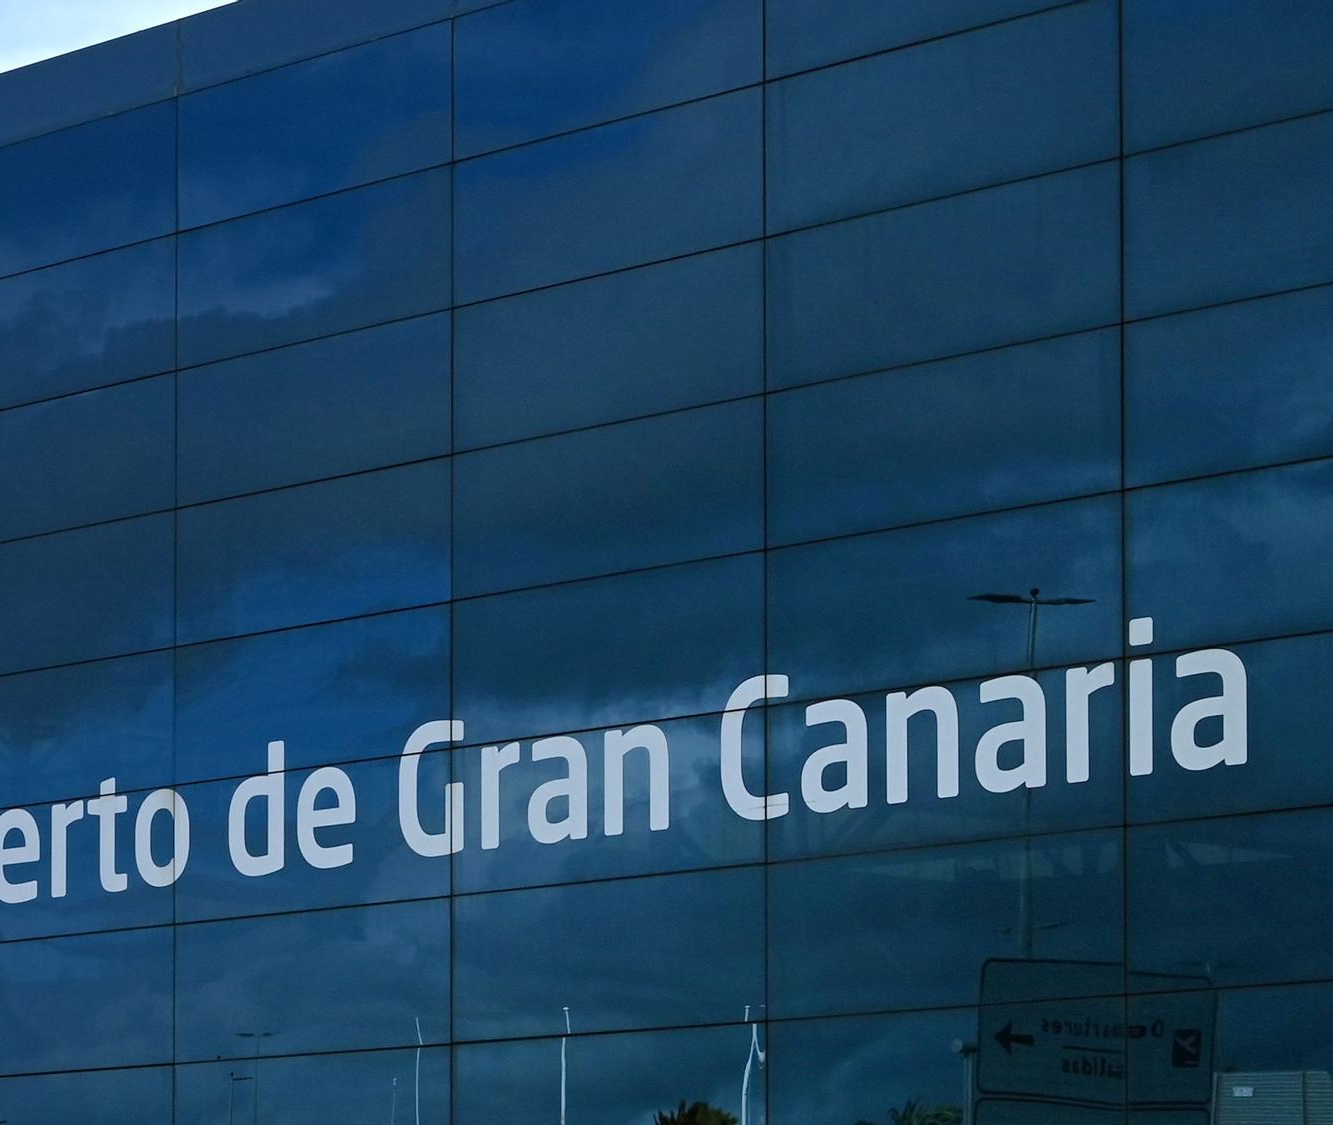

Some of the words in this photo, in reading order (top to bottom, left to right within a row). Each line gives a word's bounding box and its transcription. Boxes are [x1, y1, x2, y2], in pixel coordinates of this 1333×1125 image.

[228, 740, 358, 877] de
[397, 719, 671, 858] Gran
[719, 616, 1249, 822] Canaria
